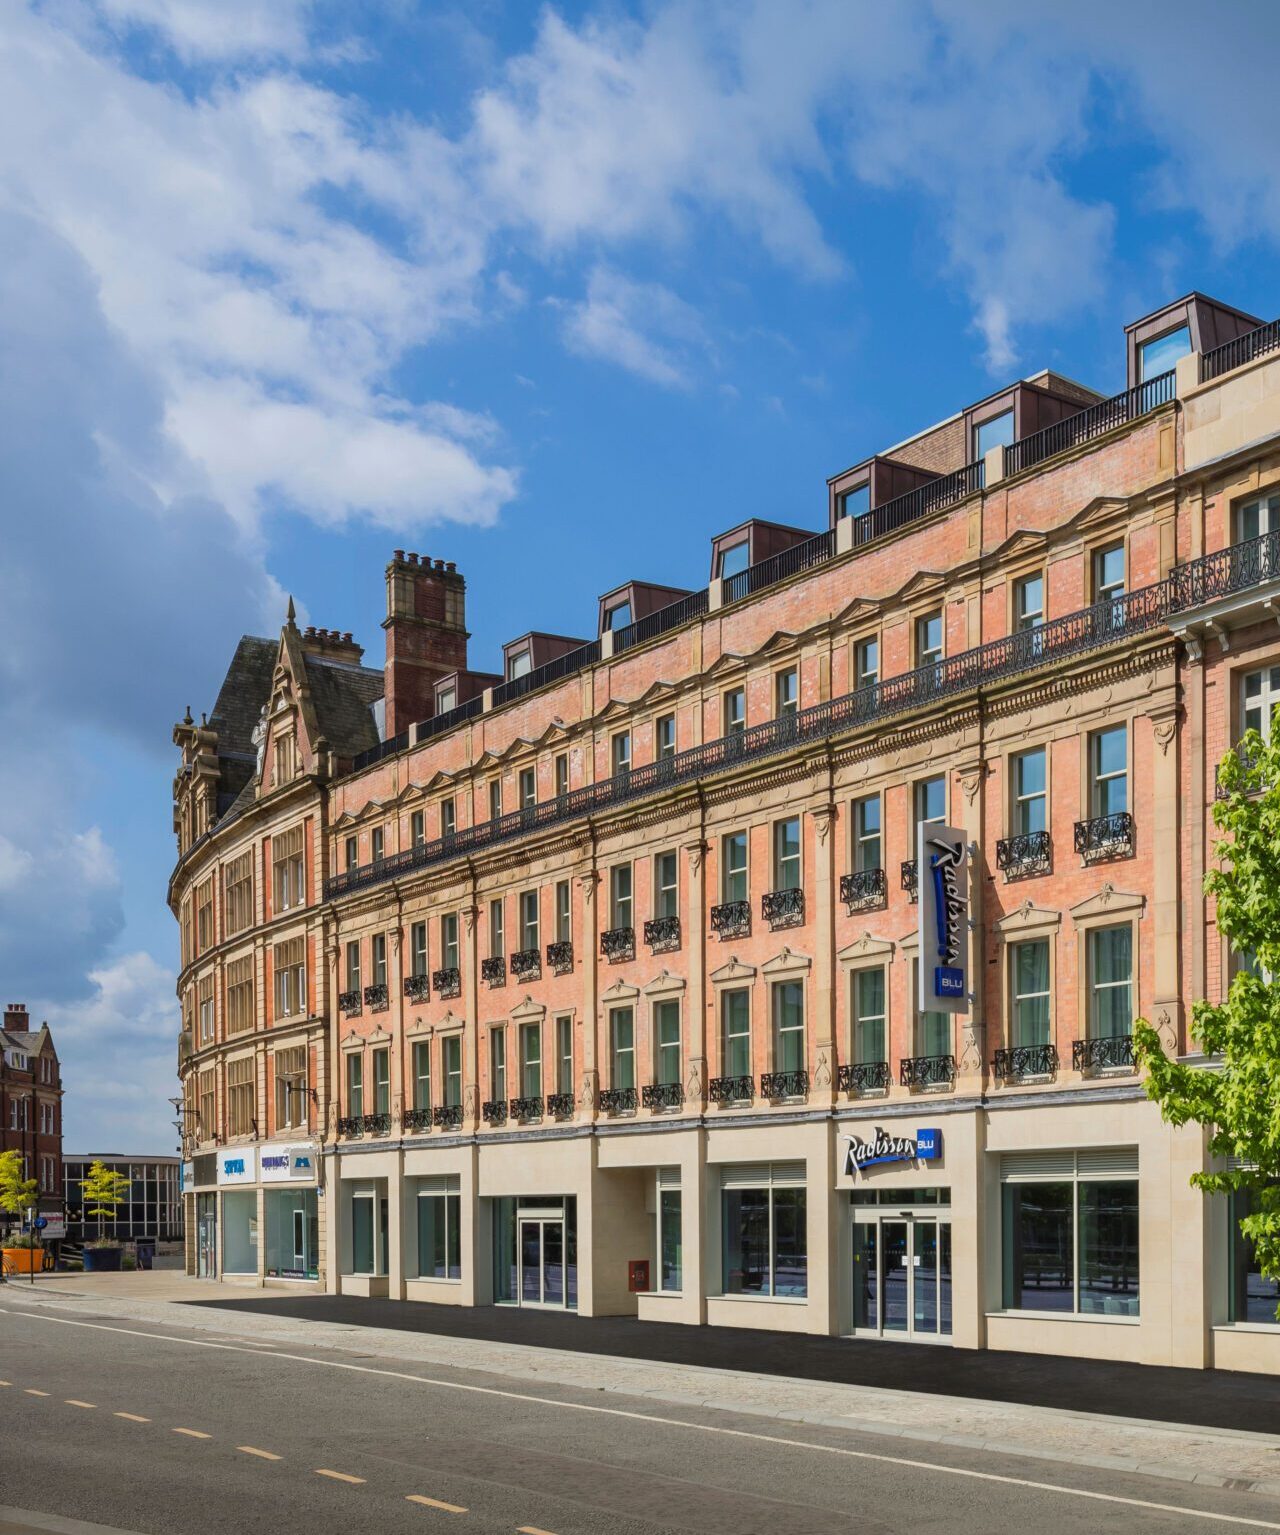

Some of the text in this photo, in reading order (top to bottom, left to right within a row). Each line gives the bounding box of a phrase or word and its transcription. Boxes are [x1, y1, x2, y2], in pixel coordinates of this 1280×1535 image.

[928, 838, 968, 965] Radisson
[941, 977, 963, 988] BLU
[842, 1126, 934, 1175] Radisson BLU
